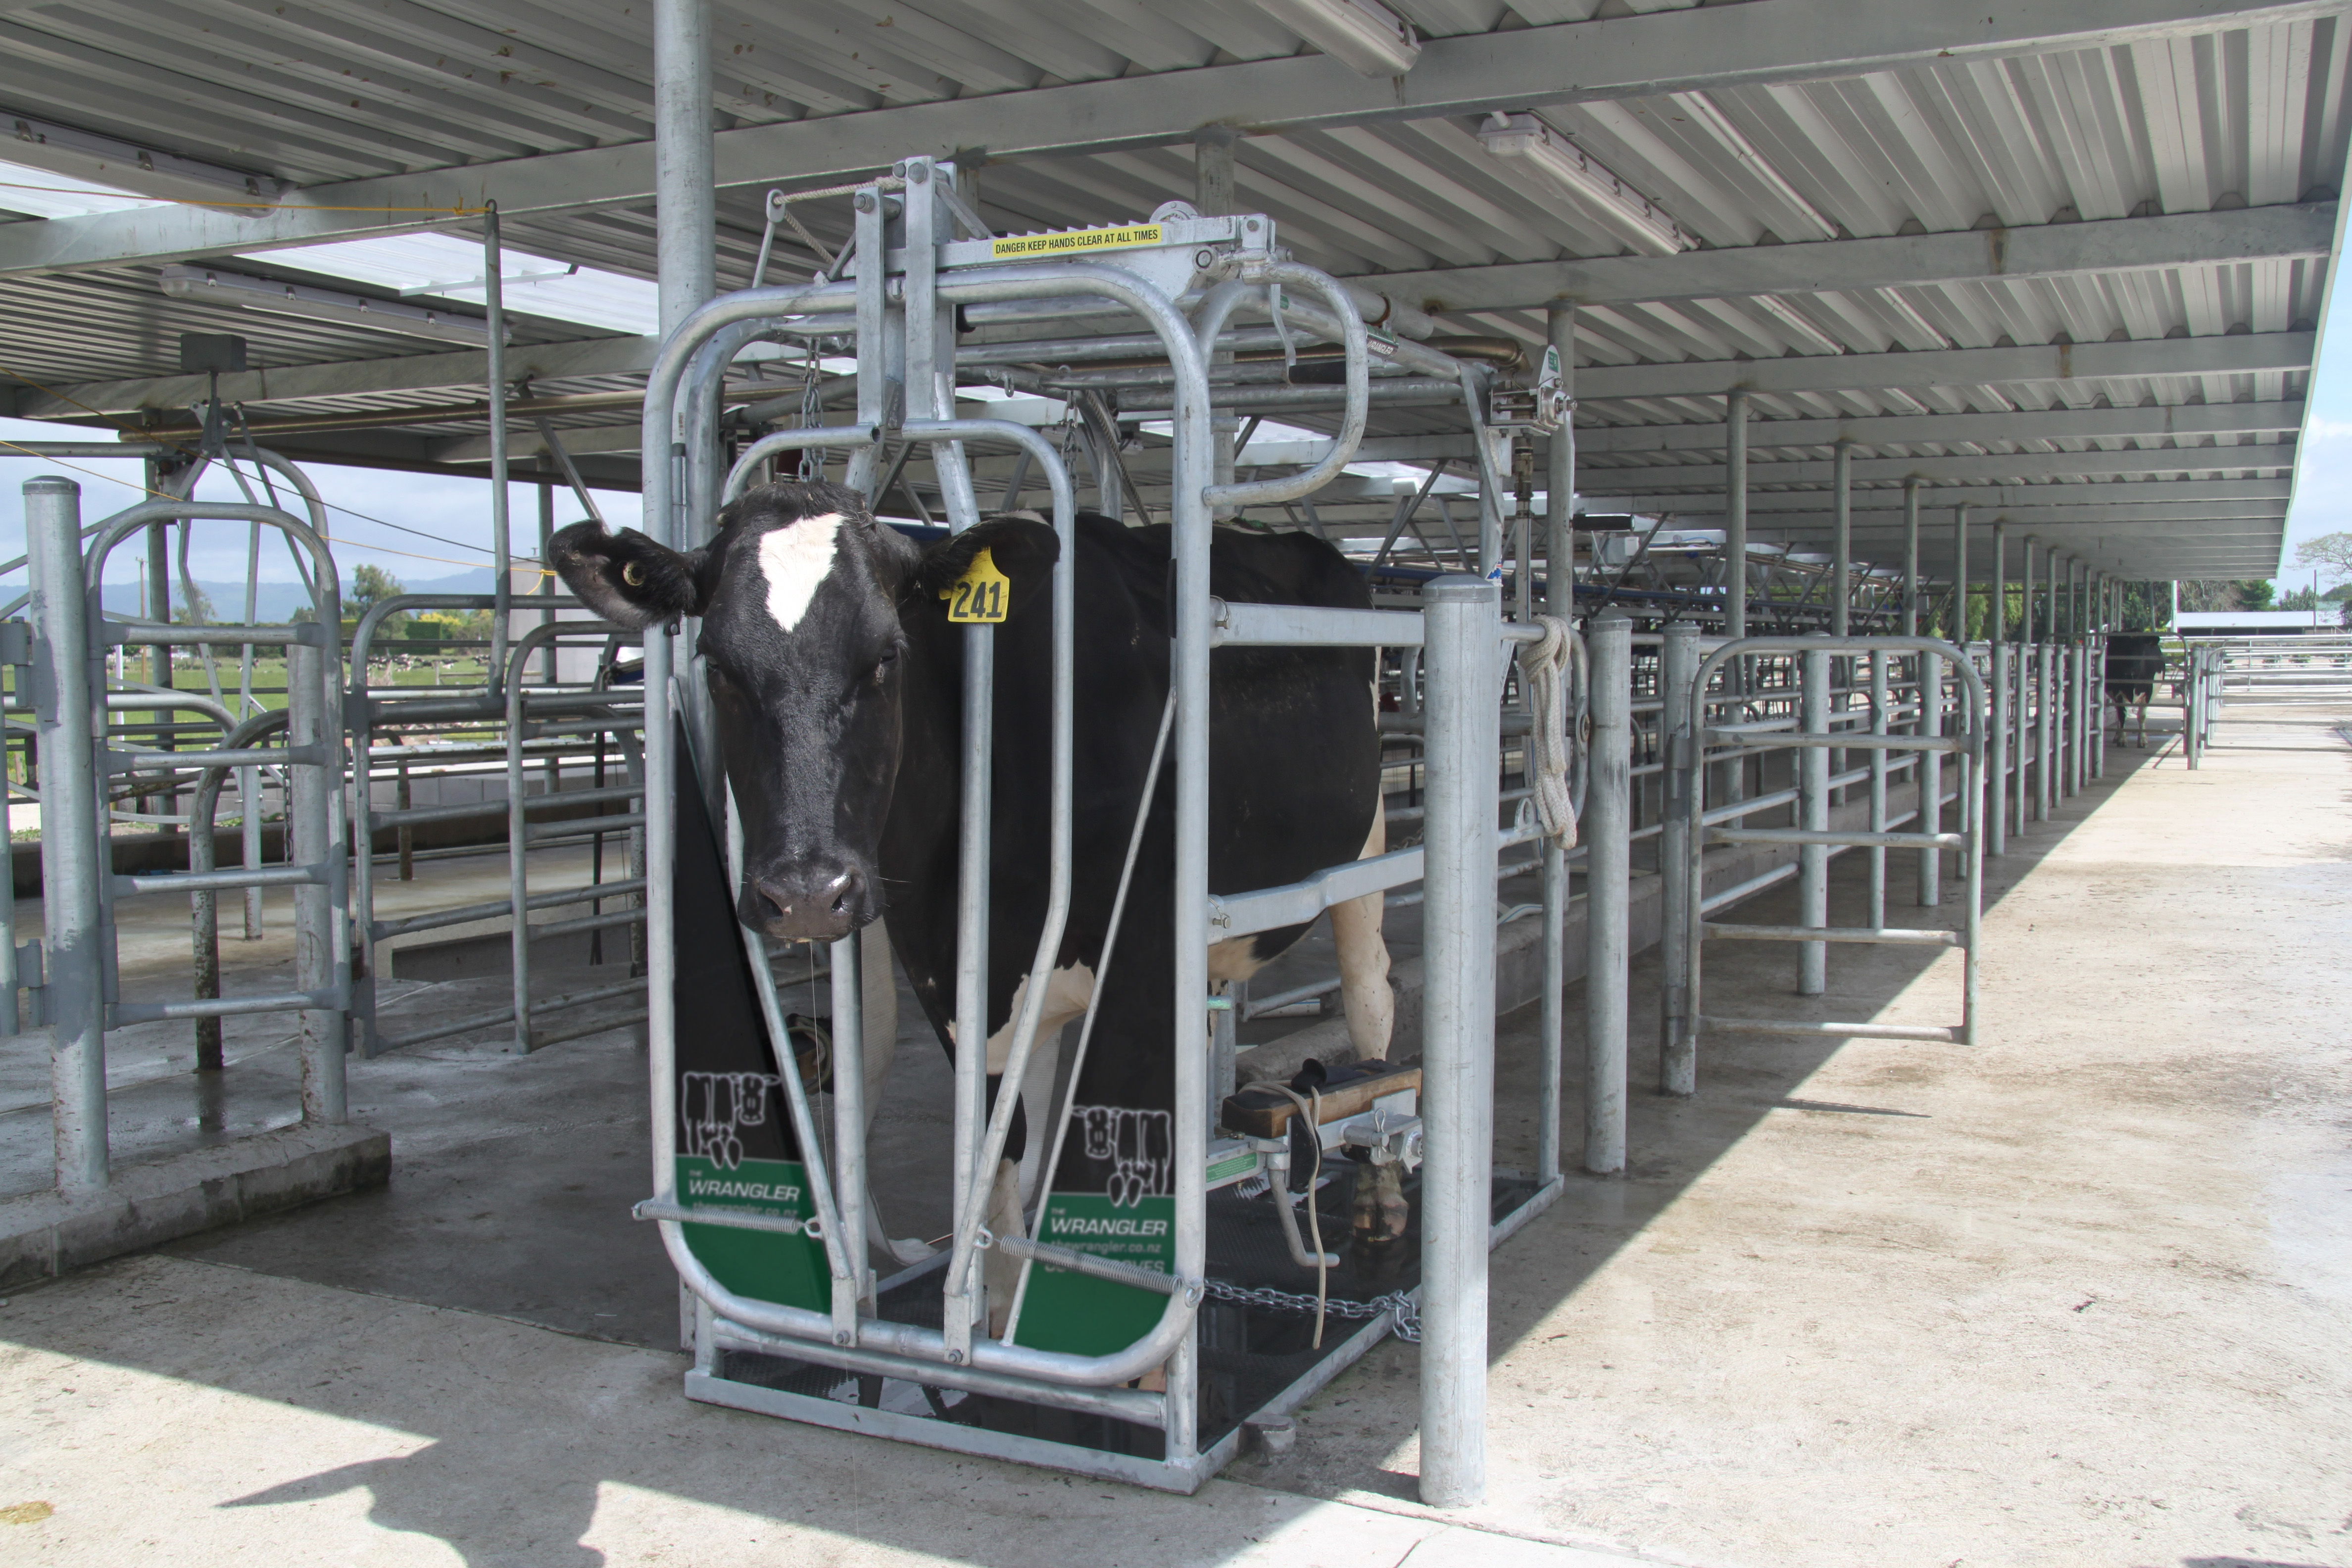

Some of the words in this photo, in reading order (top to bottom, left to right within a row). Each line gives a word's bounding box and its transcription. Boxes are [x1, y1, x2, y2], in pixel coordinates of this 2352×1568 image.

[996, 242, 1026, 254] DANGER
[1028, 239, 1047, 250] KEEP
[1049, 236, 1076, 248] HANDS
[1077, 233, 1103, 246] CLEAR
[1104, 233, 1115, 243] AT
[1117, 231, 1131, 242] ALL
[1133, 229, 1158, 241] TIMES
[953, 581, 1002, 618] 241
[689, 1180, 800, 1201] WRANGLER
[1051, 1218, 1167, 1235] WRANGLER
